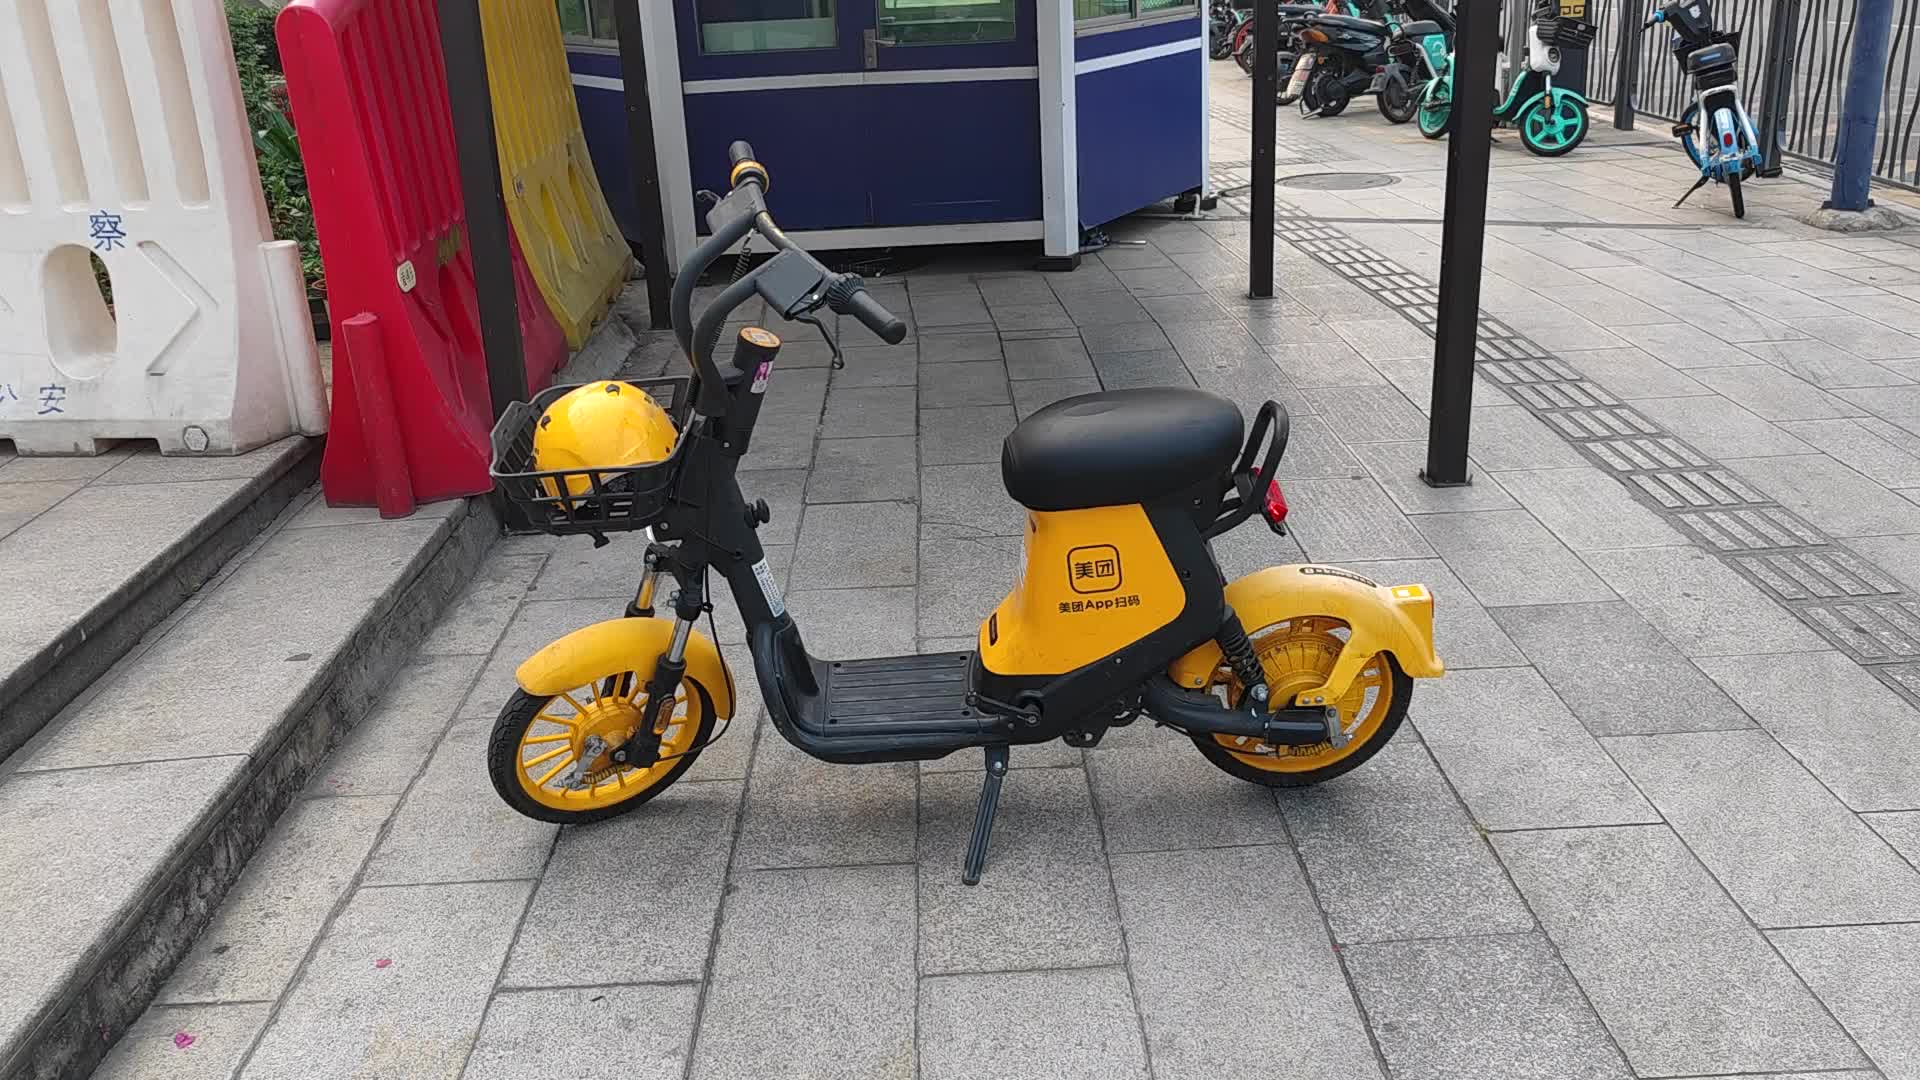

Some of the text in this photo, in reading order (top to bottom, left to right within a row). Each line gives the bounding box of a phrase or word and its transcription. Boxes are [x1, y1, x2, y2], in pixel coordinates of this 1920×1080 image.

[89, 210, 127, 251] 察
[1075, 559, 1115, 579] 美团
[1059, 595, 1140, 613] 美团App扫码
